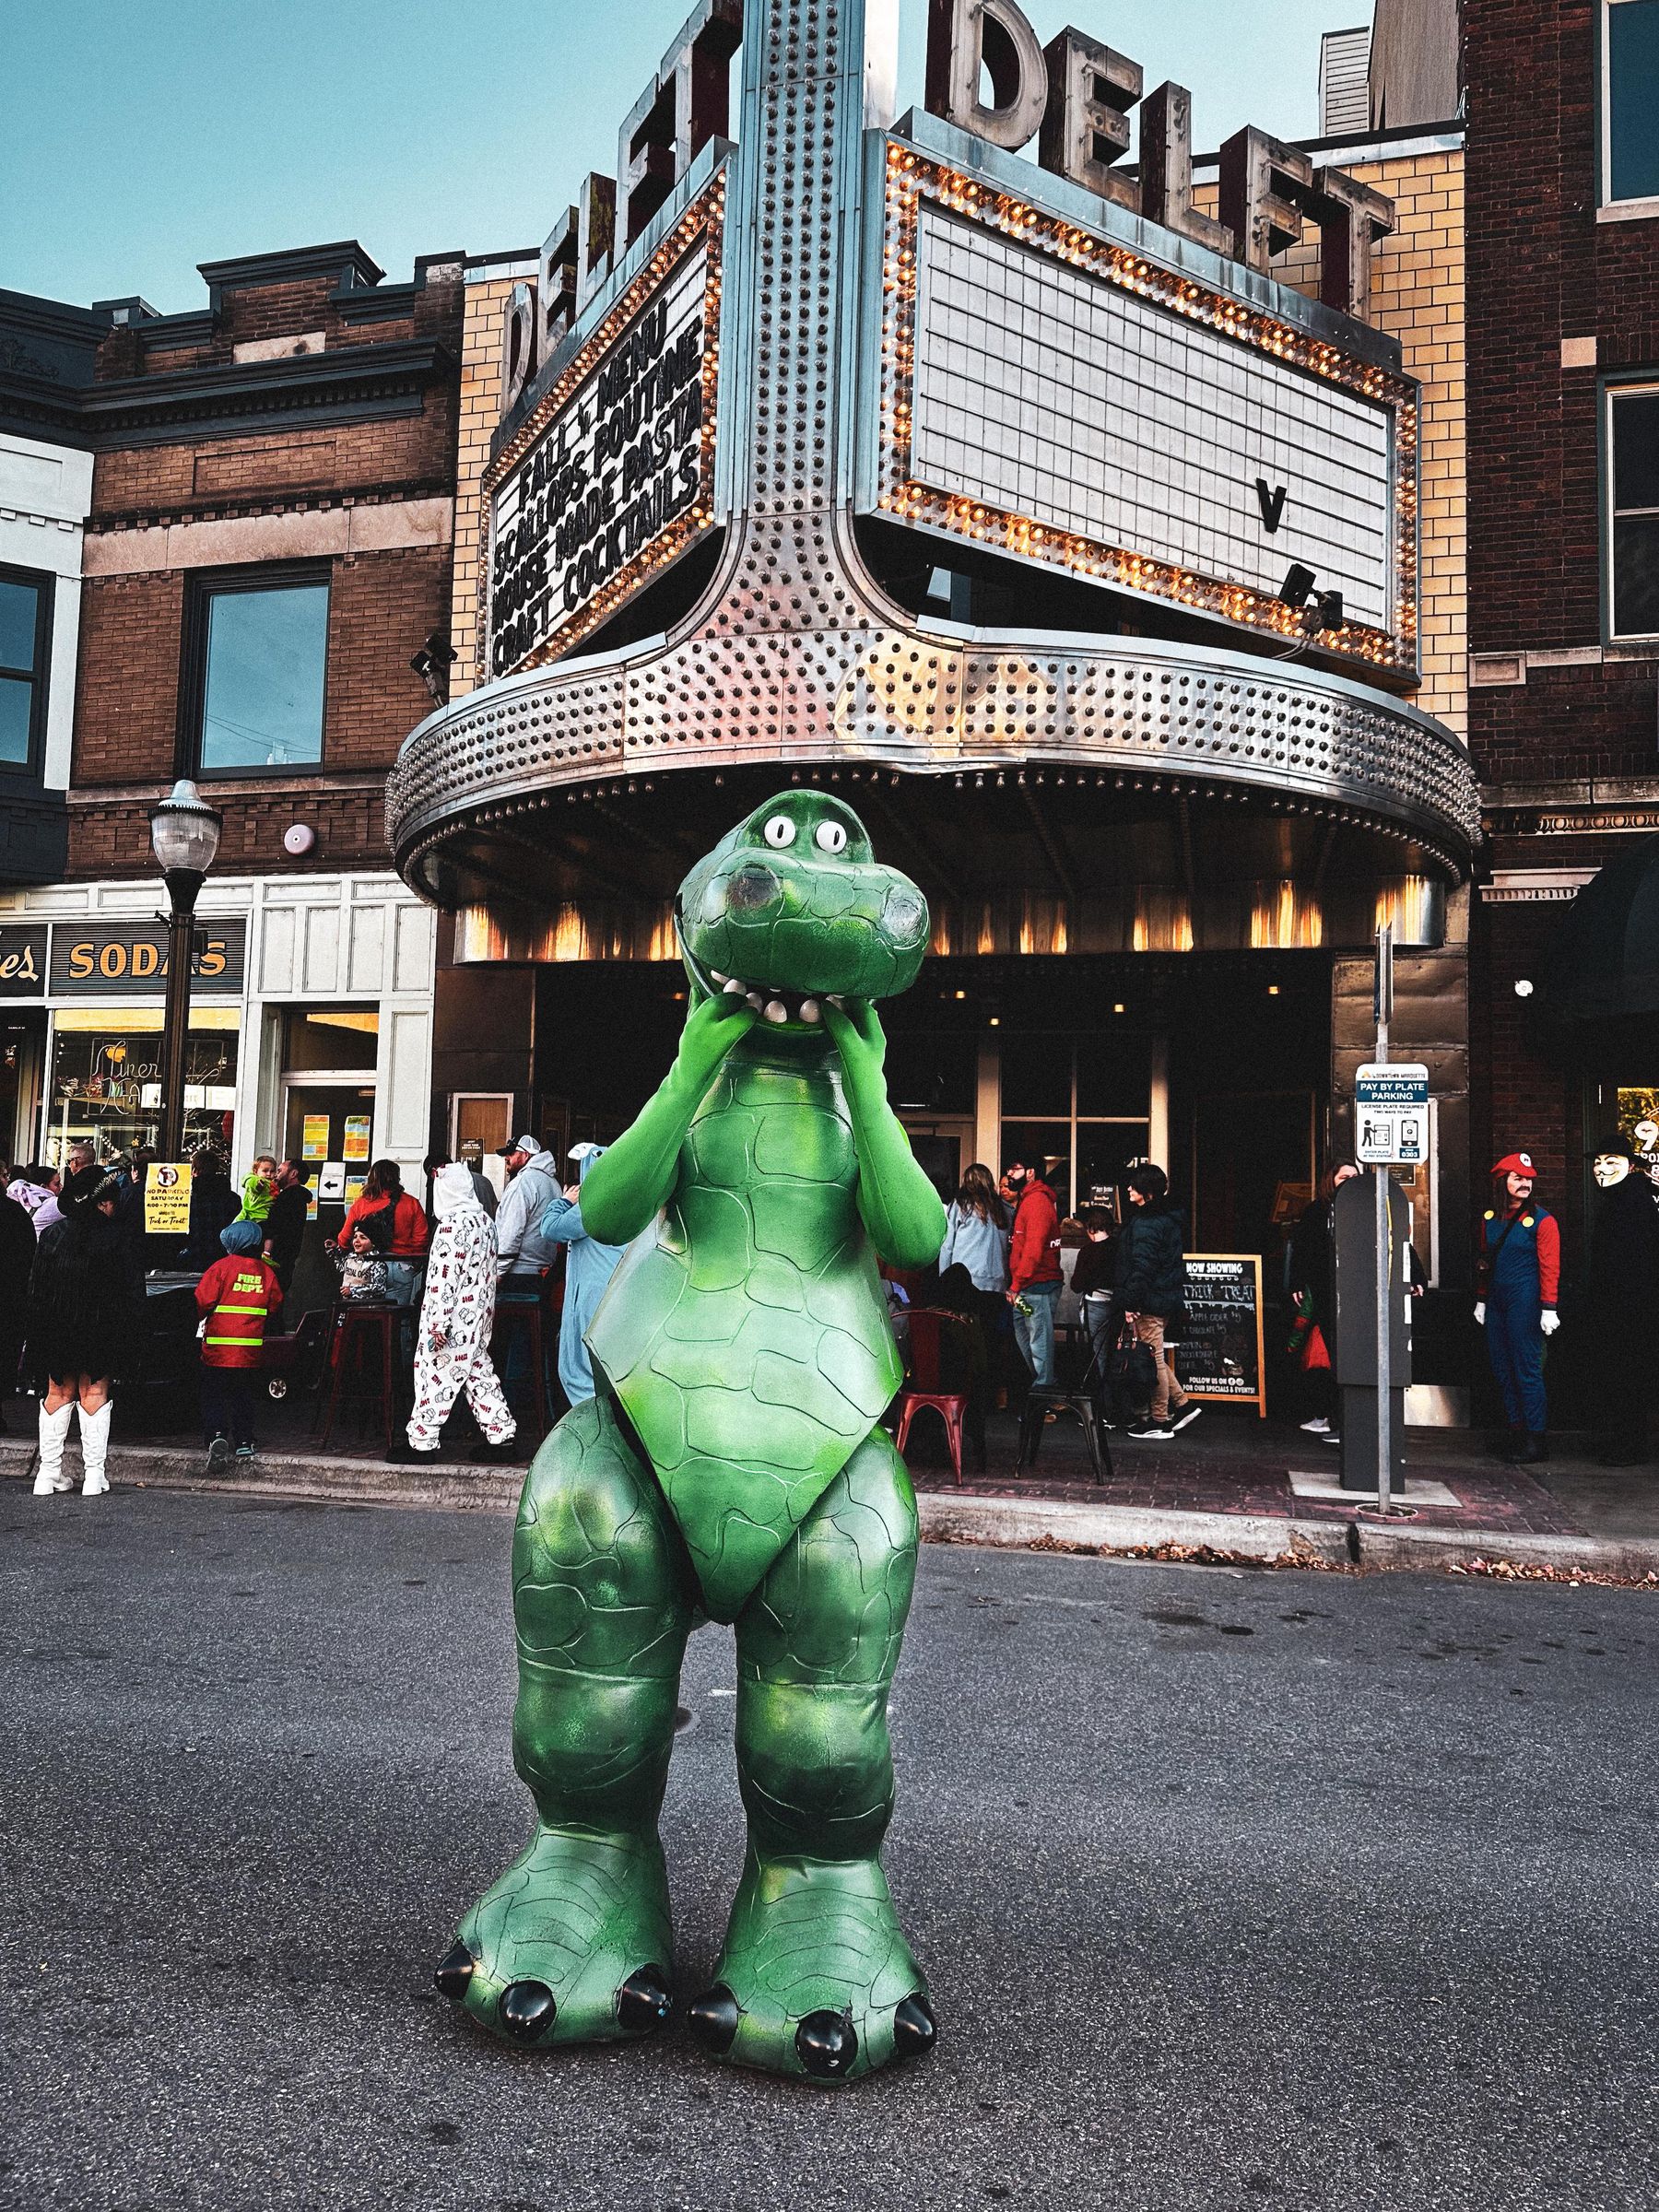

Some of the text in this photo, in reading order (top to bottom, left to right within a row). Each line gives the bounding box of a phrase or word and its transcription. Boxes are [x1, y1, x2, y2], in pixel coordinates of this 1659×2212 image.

[925, 0, 1395, 327] DELFT
[502, 0, 745, 419] DELFT
[519, 297, 667, 513] FALL MENU
[492, 314, 704, 585] SCALLOPS POUTINE
[492, 378, 702, 635] HOUSE MADE PASTA
[1255, 477, 1288, 535] V
[492, 443, 701, 677] CRAFT COCKTAILS
[68, 941, 227, 979] SODS
[1359, 1083, 1425, 1091] PAY BY PLATE
[1371, 1092, 1414, 1100] PARKING
[169, 1216, 189, 1226] Treat
[1185, 1262, 1243, 1274] NOW SHOWING
[237, 1273, 262, 1284] FIRE
[232, 1282, 265, 1293] DEPT.
[1182, 1284, 1256, 1301] TRICK TREAT
[1189, 1312, 1207, 1322] APPLE
[1189, 1376, 1211, 1384] FOLLOW
[1218, 1377, 1228, 1385] ON
